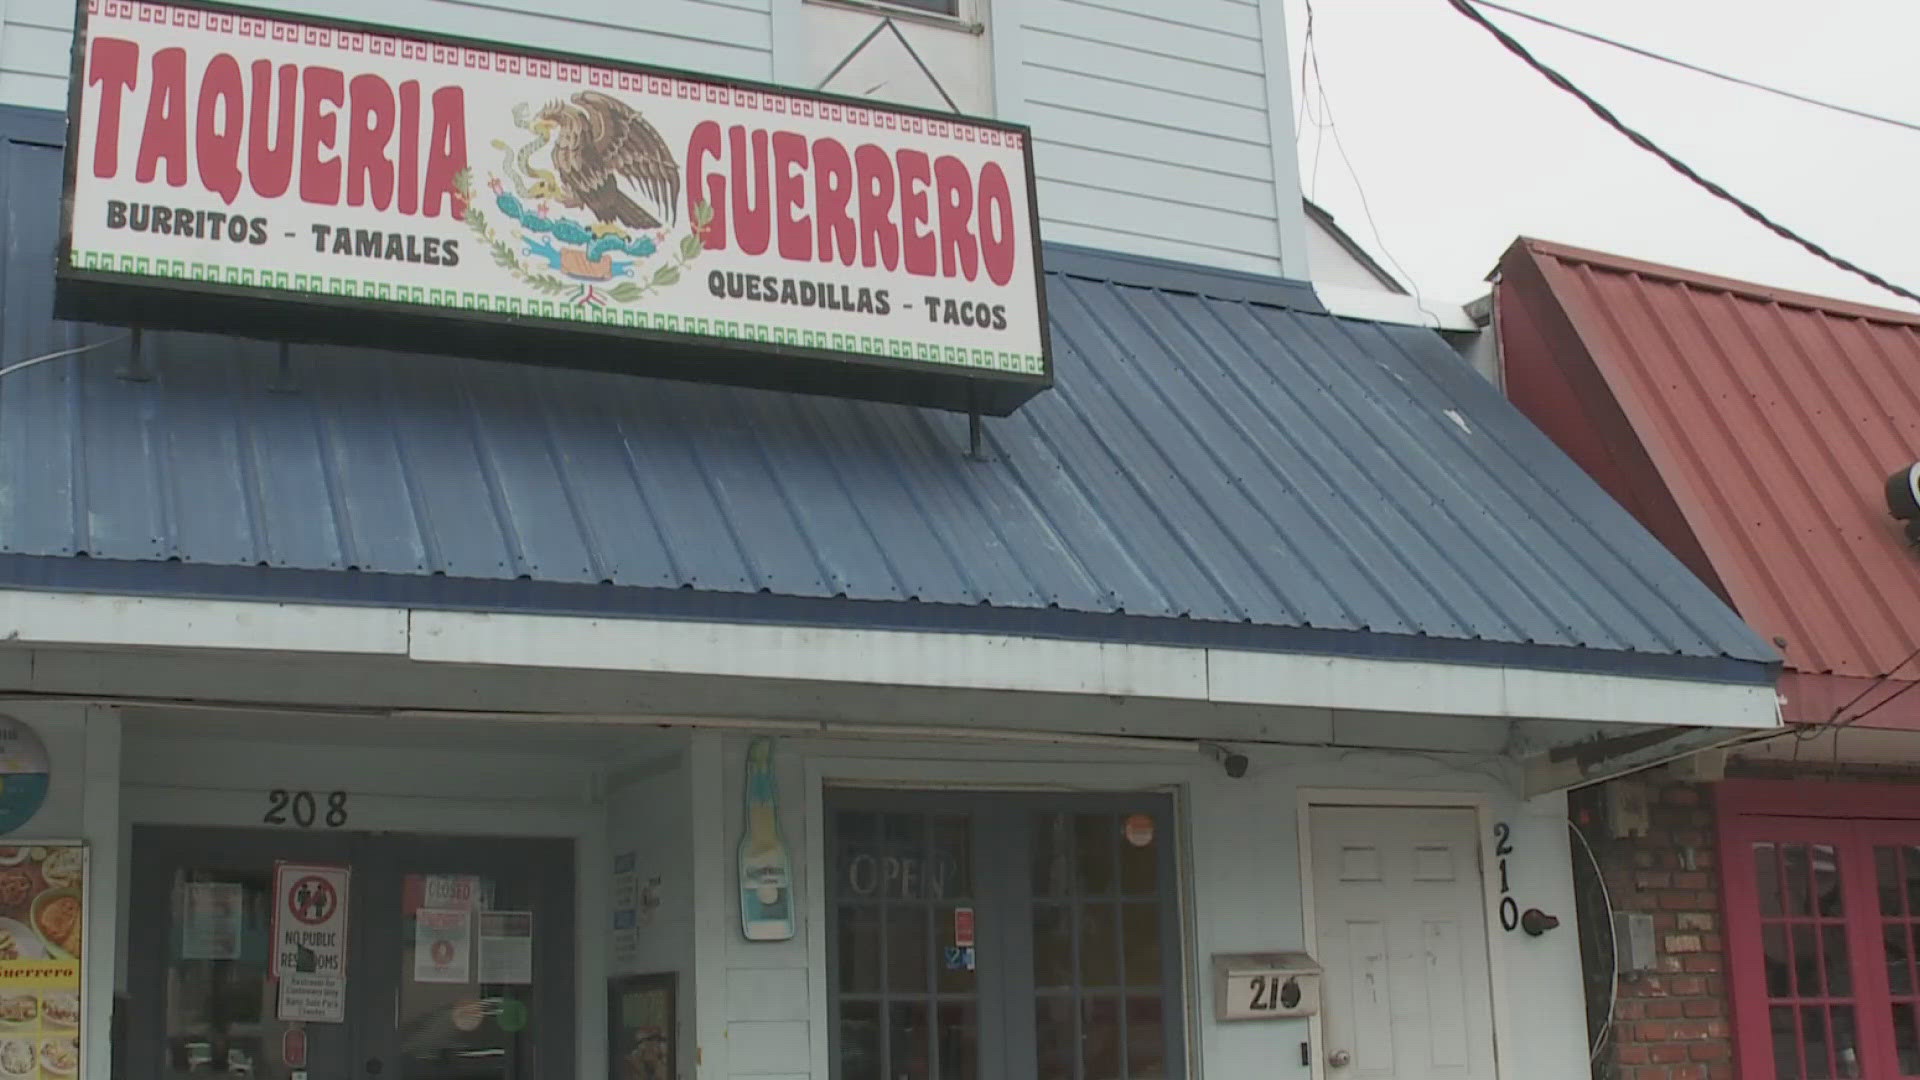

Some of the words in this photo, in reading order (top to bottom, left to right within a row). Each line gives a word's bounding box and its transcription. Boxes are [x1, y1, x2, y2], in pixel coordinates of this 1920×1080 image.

[89, 37, 468, 221] TAQUERIA
[686, 120, 1015, 286] GUERRERO
[106, 200, 268, 245] BURRITOS
[312, 224, 460, 267] TAMALES
[708, 269, 890, 315] QUESADILLAS
[924, 296, 1007, 330] TACOS
[263, 788, 348, 828] 208
[1493, 822, 1519, 933] 210
[281, 952, 339, 969] RESOMS
[285, 930, 301, 945] NO
[303, 932, 336, 947] PUBLIC
